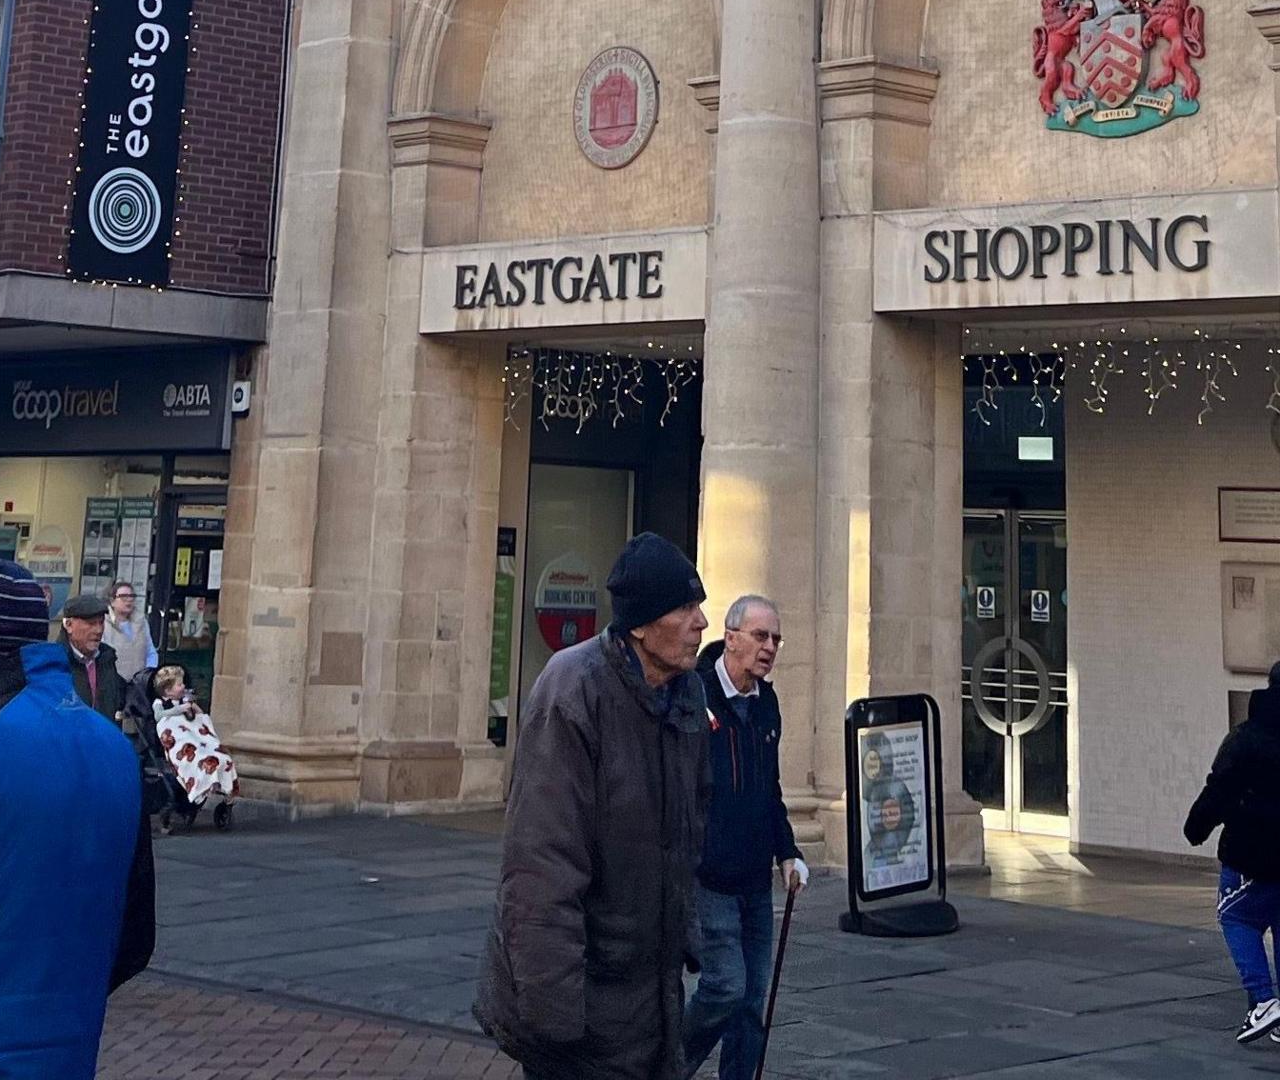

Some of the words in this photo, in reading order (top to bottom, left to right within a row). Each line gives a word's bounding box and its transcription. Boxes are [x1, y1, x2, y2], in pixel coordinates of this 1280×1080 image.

[106, 113, 122, 155] THE
[923, 214, 1211, 284] SHOPPING
[454, 250, 664, 310] EASTGATE
[64, 379, 119, 416] travel
[175, 384, 211, 406] ABTA
